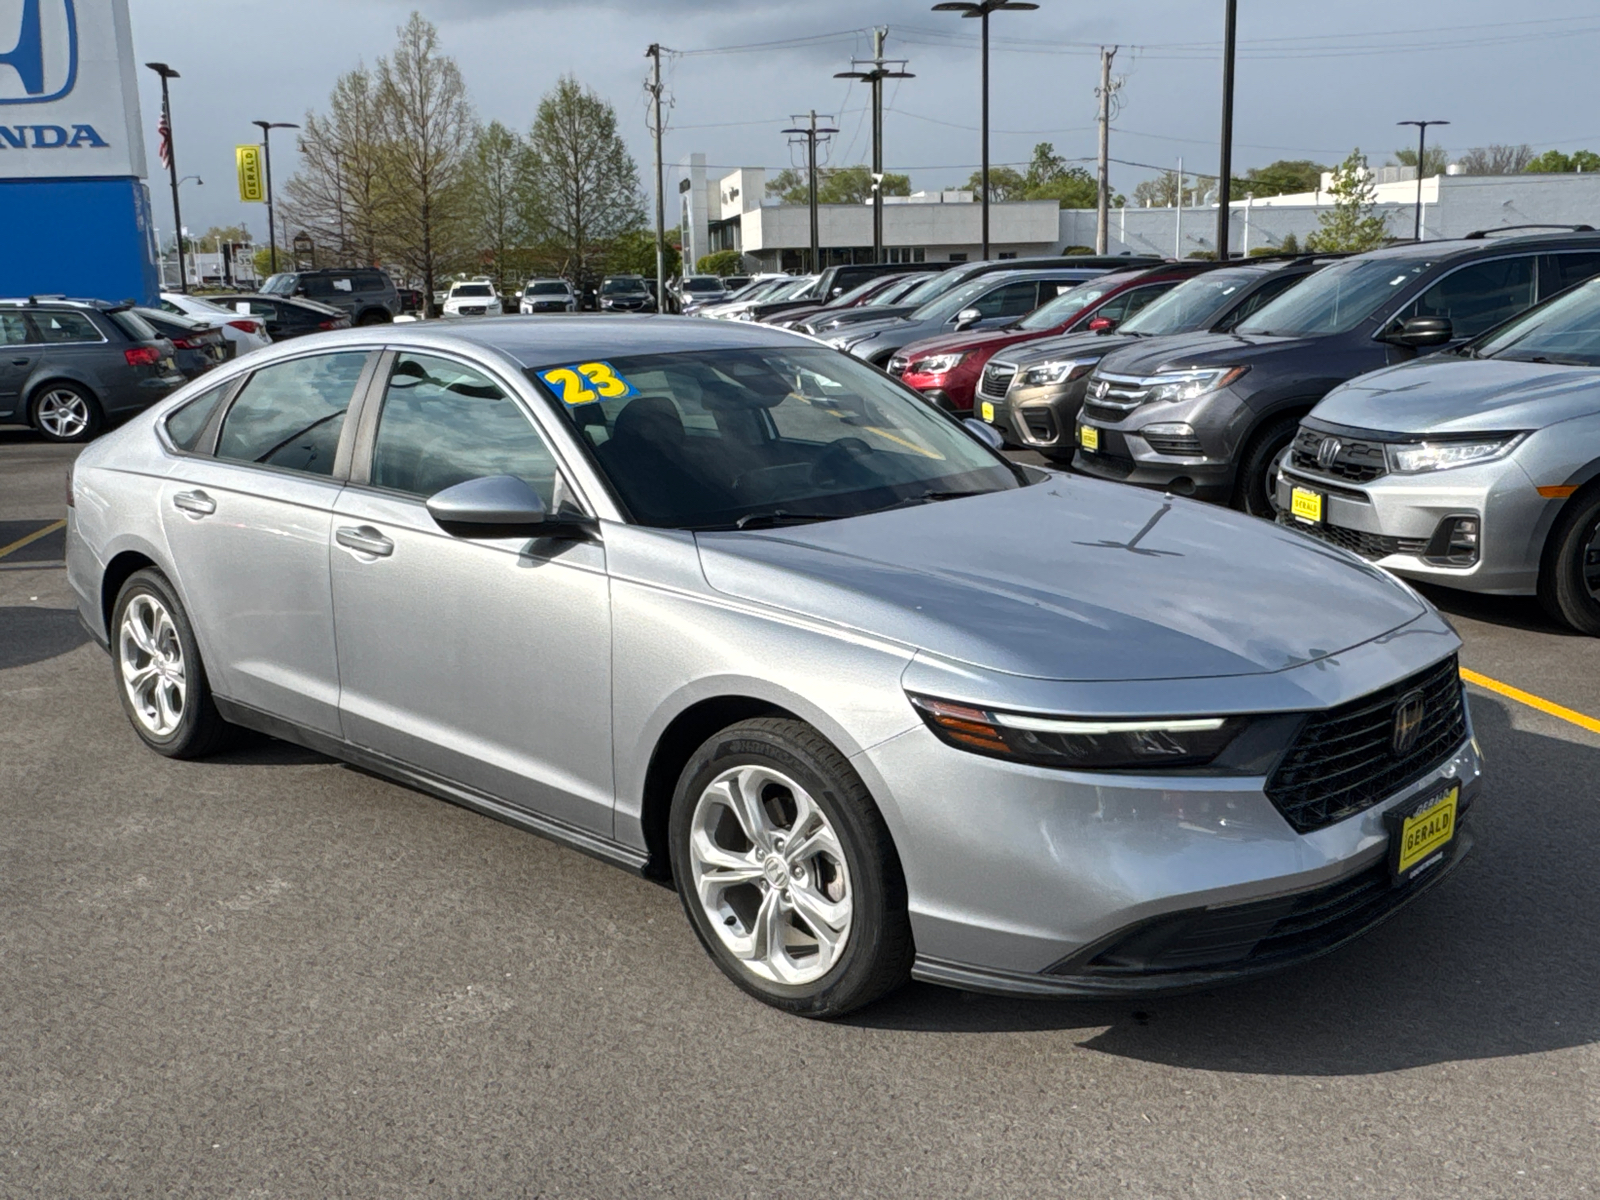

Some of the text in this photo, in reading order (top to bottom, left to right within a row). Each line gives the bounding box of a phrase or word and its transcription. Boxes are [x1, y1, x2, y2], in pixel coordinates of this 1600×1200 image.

[245, 152, 257, 195] GERALD
[544, 362, 627, 404] 23
[1407, 813, 1449, 851] GERALD
